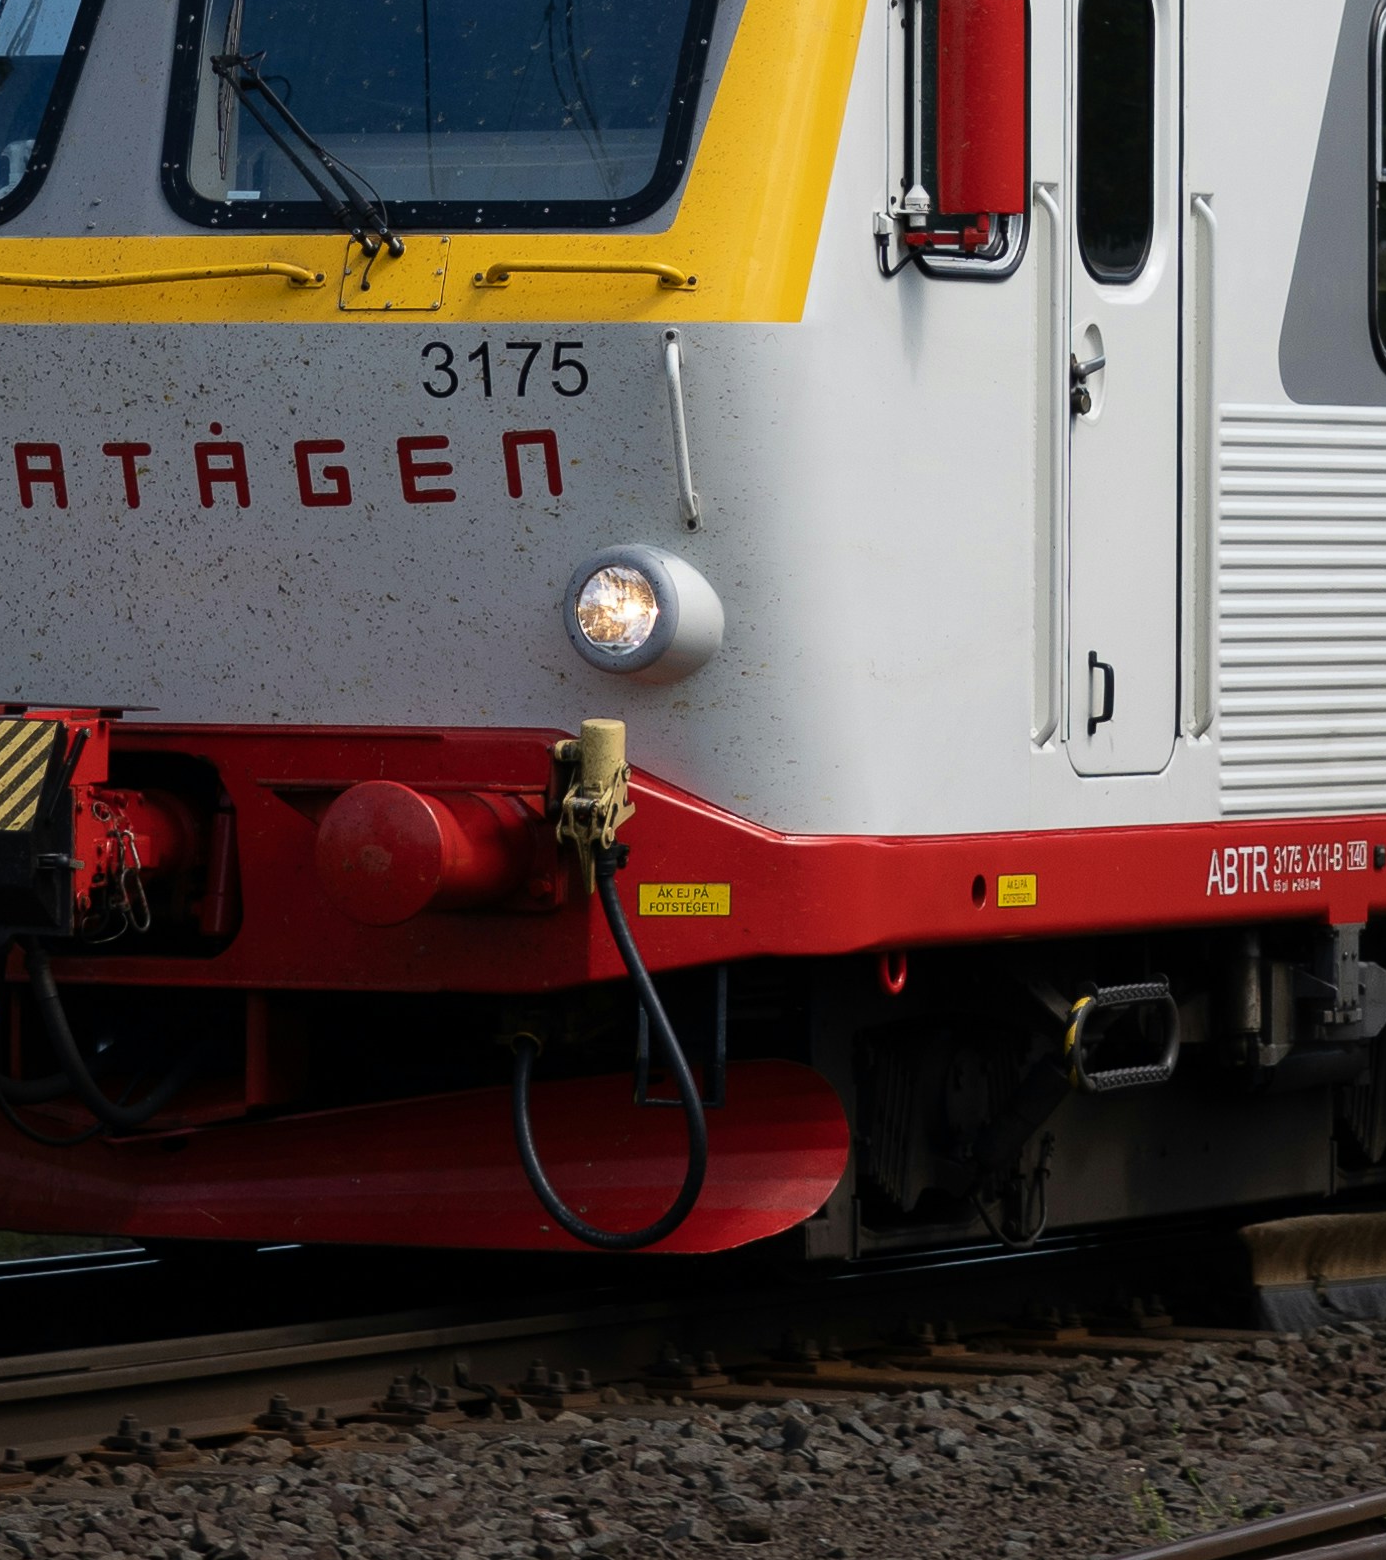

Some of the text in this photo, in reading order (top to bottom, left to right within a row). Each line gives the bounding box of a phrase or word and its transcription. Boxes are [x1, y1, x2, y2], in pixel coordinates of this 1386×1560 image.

[420, 340, 591, 399] 3175
[657, 886, 710, 899] ÅK EJ PÅ
[1206, 842, 1367, 896] ABTR 3175 X11-B 140
